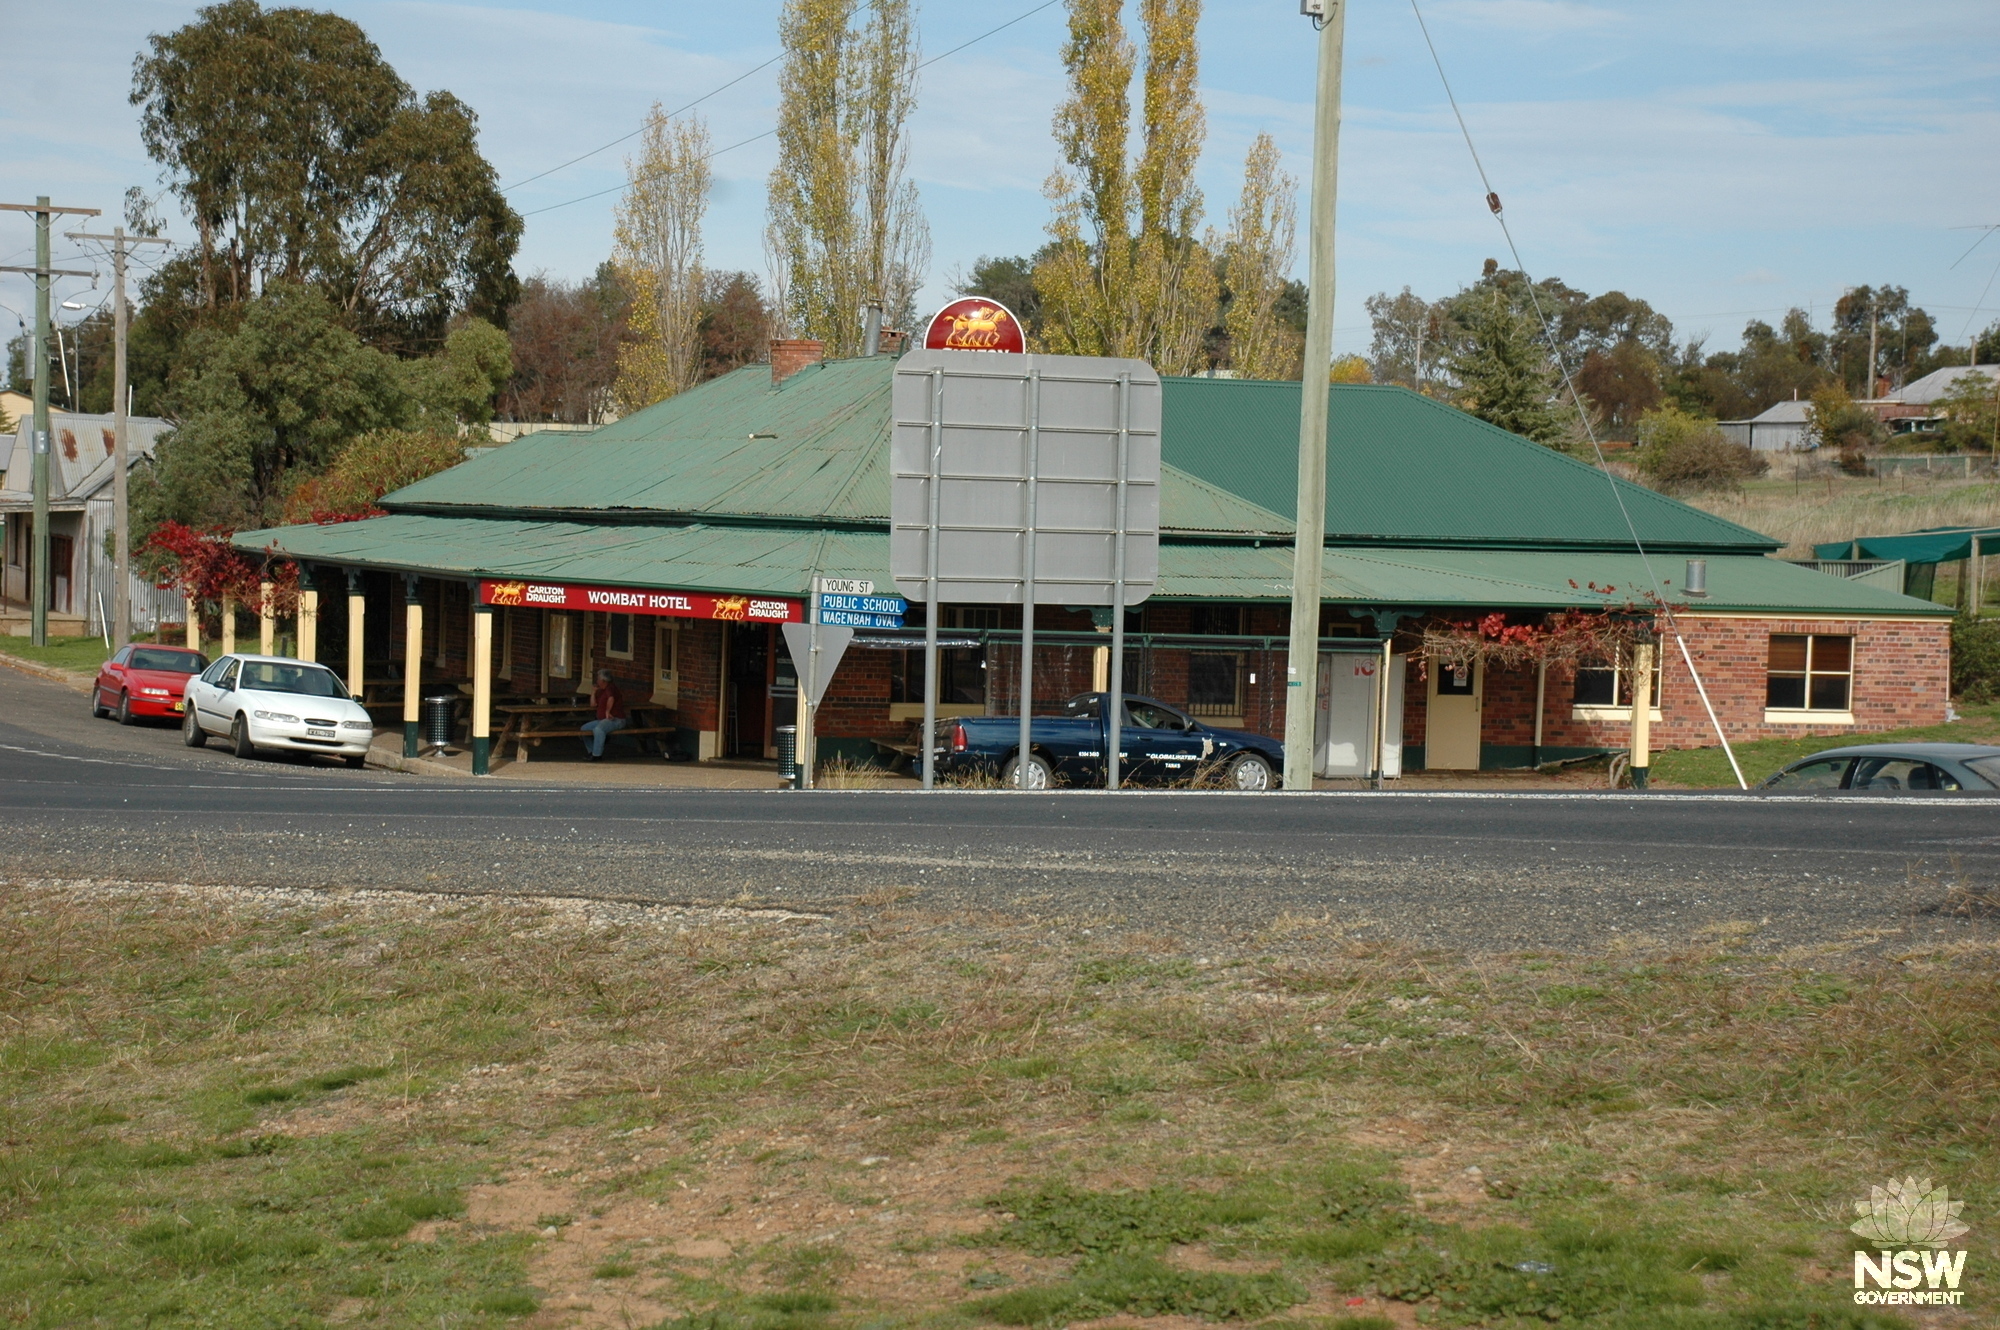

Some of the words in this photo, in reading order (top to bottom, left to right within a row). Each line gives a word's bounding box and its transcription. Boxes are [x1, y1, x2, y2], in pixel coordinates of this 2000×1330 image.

[527, 585, 564, 595] CARLTON
[826, 580, 854, 592] YOUNG
[859, 581, 869, 593] ST
[526, 592, 566, 604] DRAUGHT
[588, 591, 645, 607] WOMBAT
[649, 595, 692, 610] HOTEL
[823, 595, 858, 610] PUBLIC
[862, 598, 901, 612] SCHOOL
[750, 600, 788, 610] CARLTON
[748, 607, 790, 619] DRAUGHT
[822, 611, 871, 626] WAGENBAH
[875, 615, 897, 628] OVAL
[1354, 659, 1376, 676] IC
